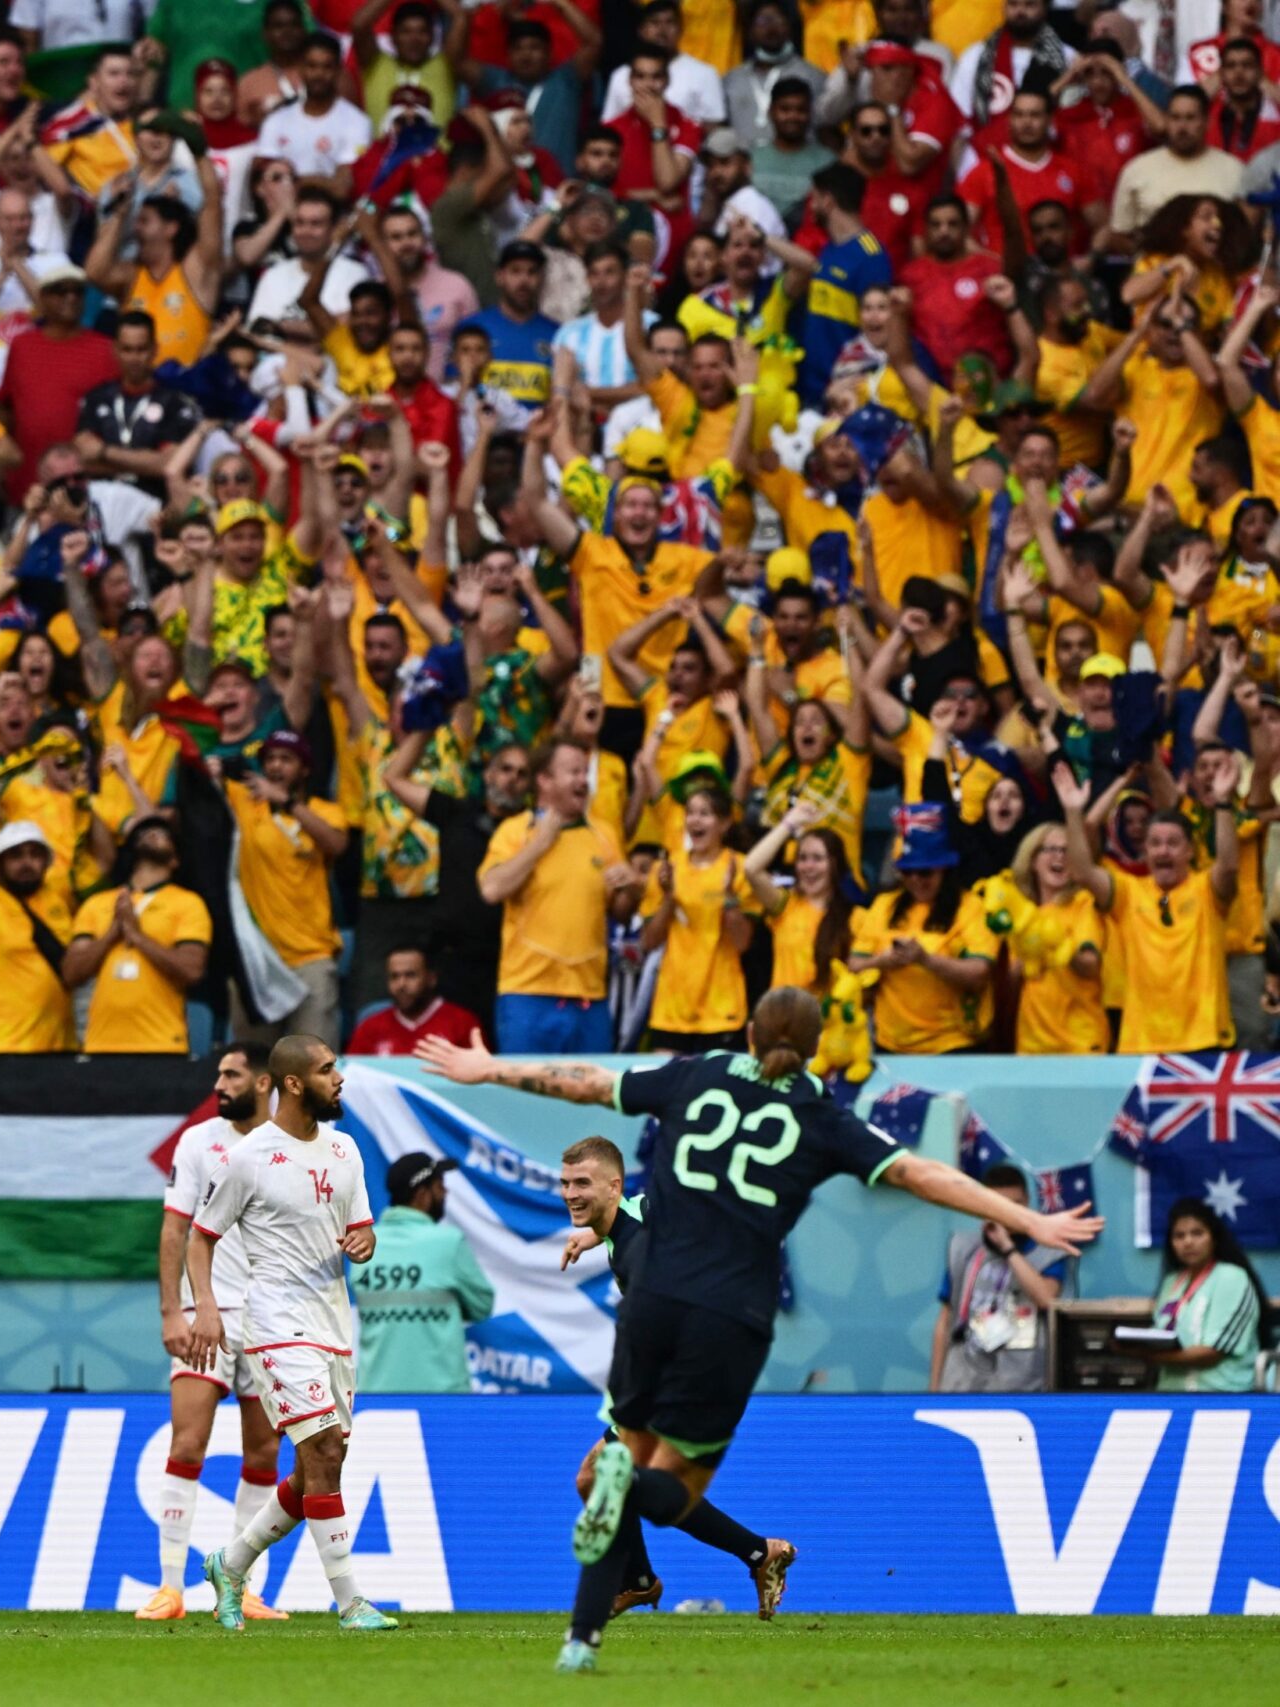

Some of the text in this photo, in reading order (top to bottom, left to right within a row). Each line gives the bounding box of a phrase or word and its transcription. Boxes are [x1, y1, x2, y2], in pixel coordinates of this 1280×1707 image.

[673, 1088, 801, 1207] 22
[308, 1168, 333, 1204] 14
[359, 1265, 422, 1290] 4599
[464, 1341, 552, 1388] QATAR
[164, 1509, 185, 1521] FTF
[914, 1409, 1280, 1615] VI
